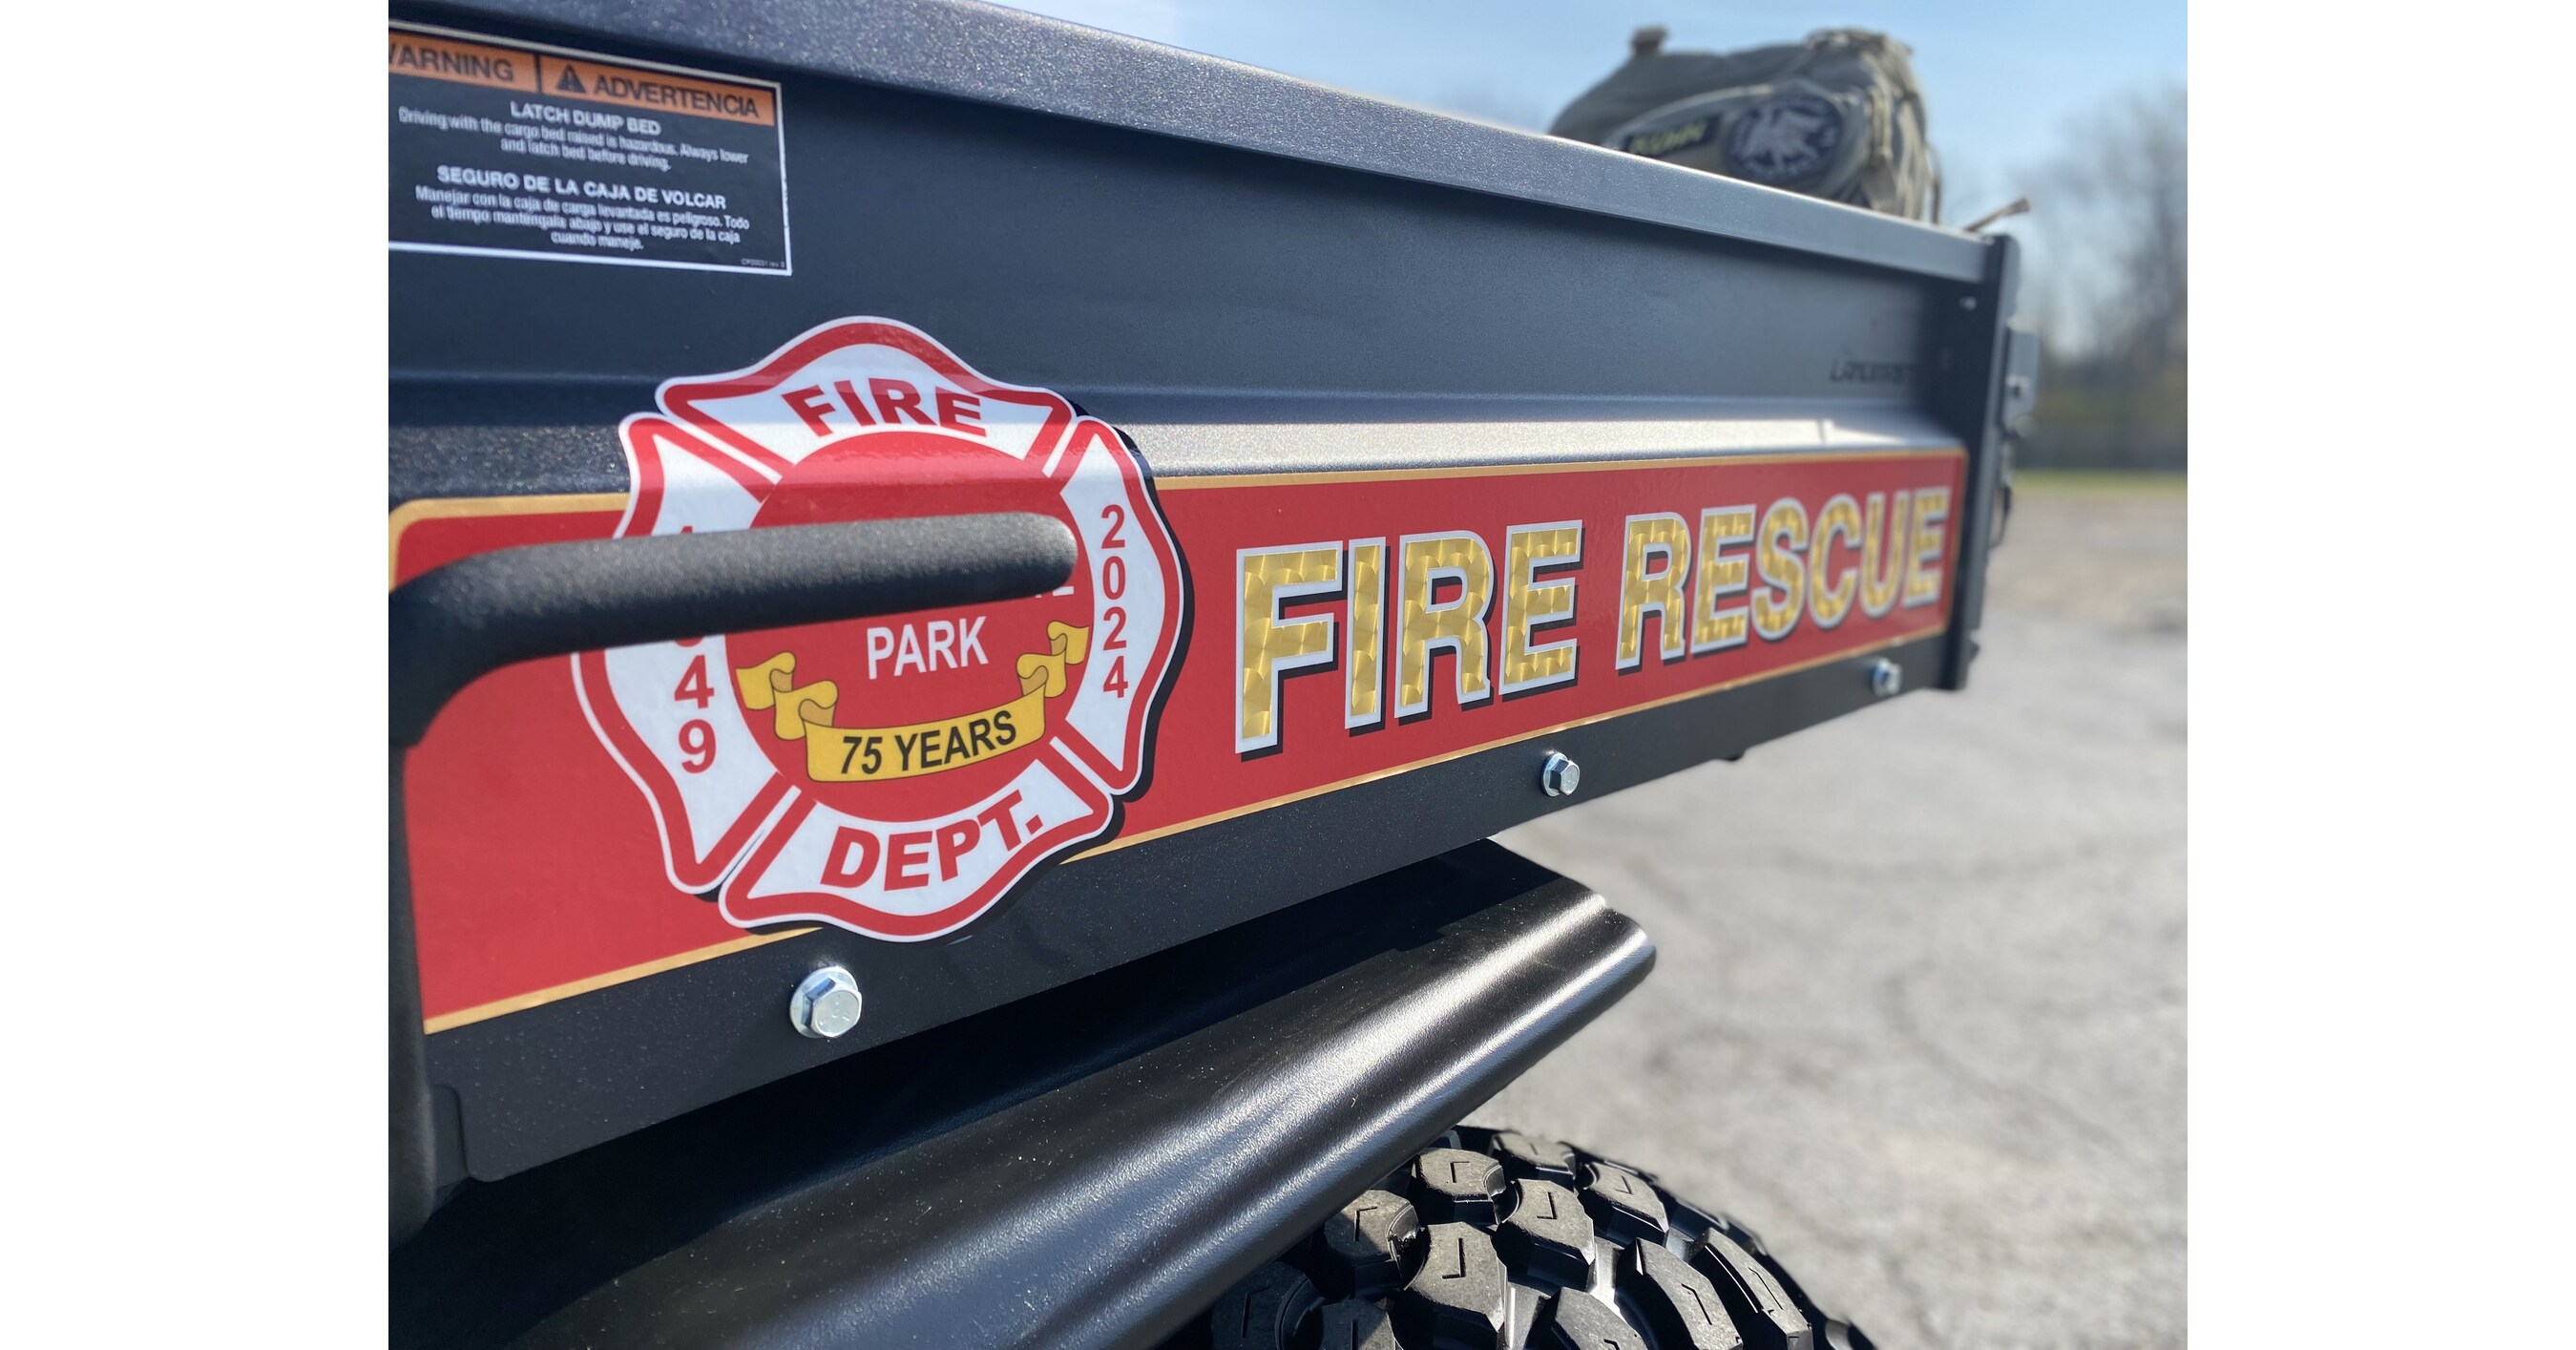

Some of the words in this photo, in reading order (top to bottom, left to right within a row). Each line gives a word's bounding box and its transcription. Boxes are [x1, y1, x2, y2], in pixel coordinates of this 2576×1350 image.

[511, 100, 570, 124] LATCH
[573, 109, 624, 130] DUMP
[626, 116, 661, 136] BED
[595, 75, 760, 117] ADVERTENCIA
[398, 106, 449, 130] Driving
[448, 114, 478, 131] with
[480, 116, 502, 134] the
[504, 122, 539, 139] cargo
[541, 125, 566, 142] bed
[567, 130, 604, 146] raised
[606, 134, 618, 149] is
[619, 136, 679, 156] hazardous.
[680, 143, 719, 163] Always
[720, 148, 749, 164] lower
[500, 137, 526, 153] and
[528, 140, 560, 158] latch
[561, 144, 586, 160] bed
[588, 147, 626, 165] before
[627, 153, 672, 172] driving.
[415, 184, 471, 205] Manejar
[471, 193, 497, 207] con
[499, 193, 513, 208] la
[513, 197, 541, 214] caja
[543, 199, 560, 213] de
[561, 202, 597, 218] carga
[597, 203, 655, 221] levantada
[657, 210, 671, 222] es
[672, 212, 723, 228] peligroso.
[723, 215, 750, 230] Todo
[437, 164, 520, 190] SEGURO
[523, 174, 551, 193] DE
[555, 178, 580, 196] LA
[583, 180, 631, 201] CAJA
[634, 186, 659, 203] DE
[661, 189, 726, 210] VOLCAR
[430, 205, 445, 219] el
[447, 206, 492, 225] tiempo
[569, 217, 603, 233] abajo
[603, 221, 613, 235] y
[613, 221, 635, 234] use
[637, 222, 650, 235] el
[651, 224, 688, 241] seguro
[689, 226, 704, 241] de
[705, 227, 716, 242] la
[718, 230, 741, 245] caja
[550, 230, 597, 246] cuando
[782, 377, 987, 436] FIRE
[1100, 504, 1130, 700] 2024
[1235, 519, 1584, 754] FIRE
[1616, 486, 1949, 670] RESCUE
[867, 616, 990, 681] PARK
[840, 735, 883, 775] 75
[893, 709, 1018, 772] YEARS
[820, 789, 1045, 892] DEPT.
